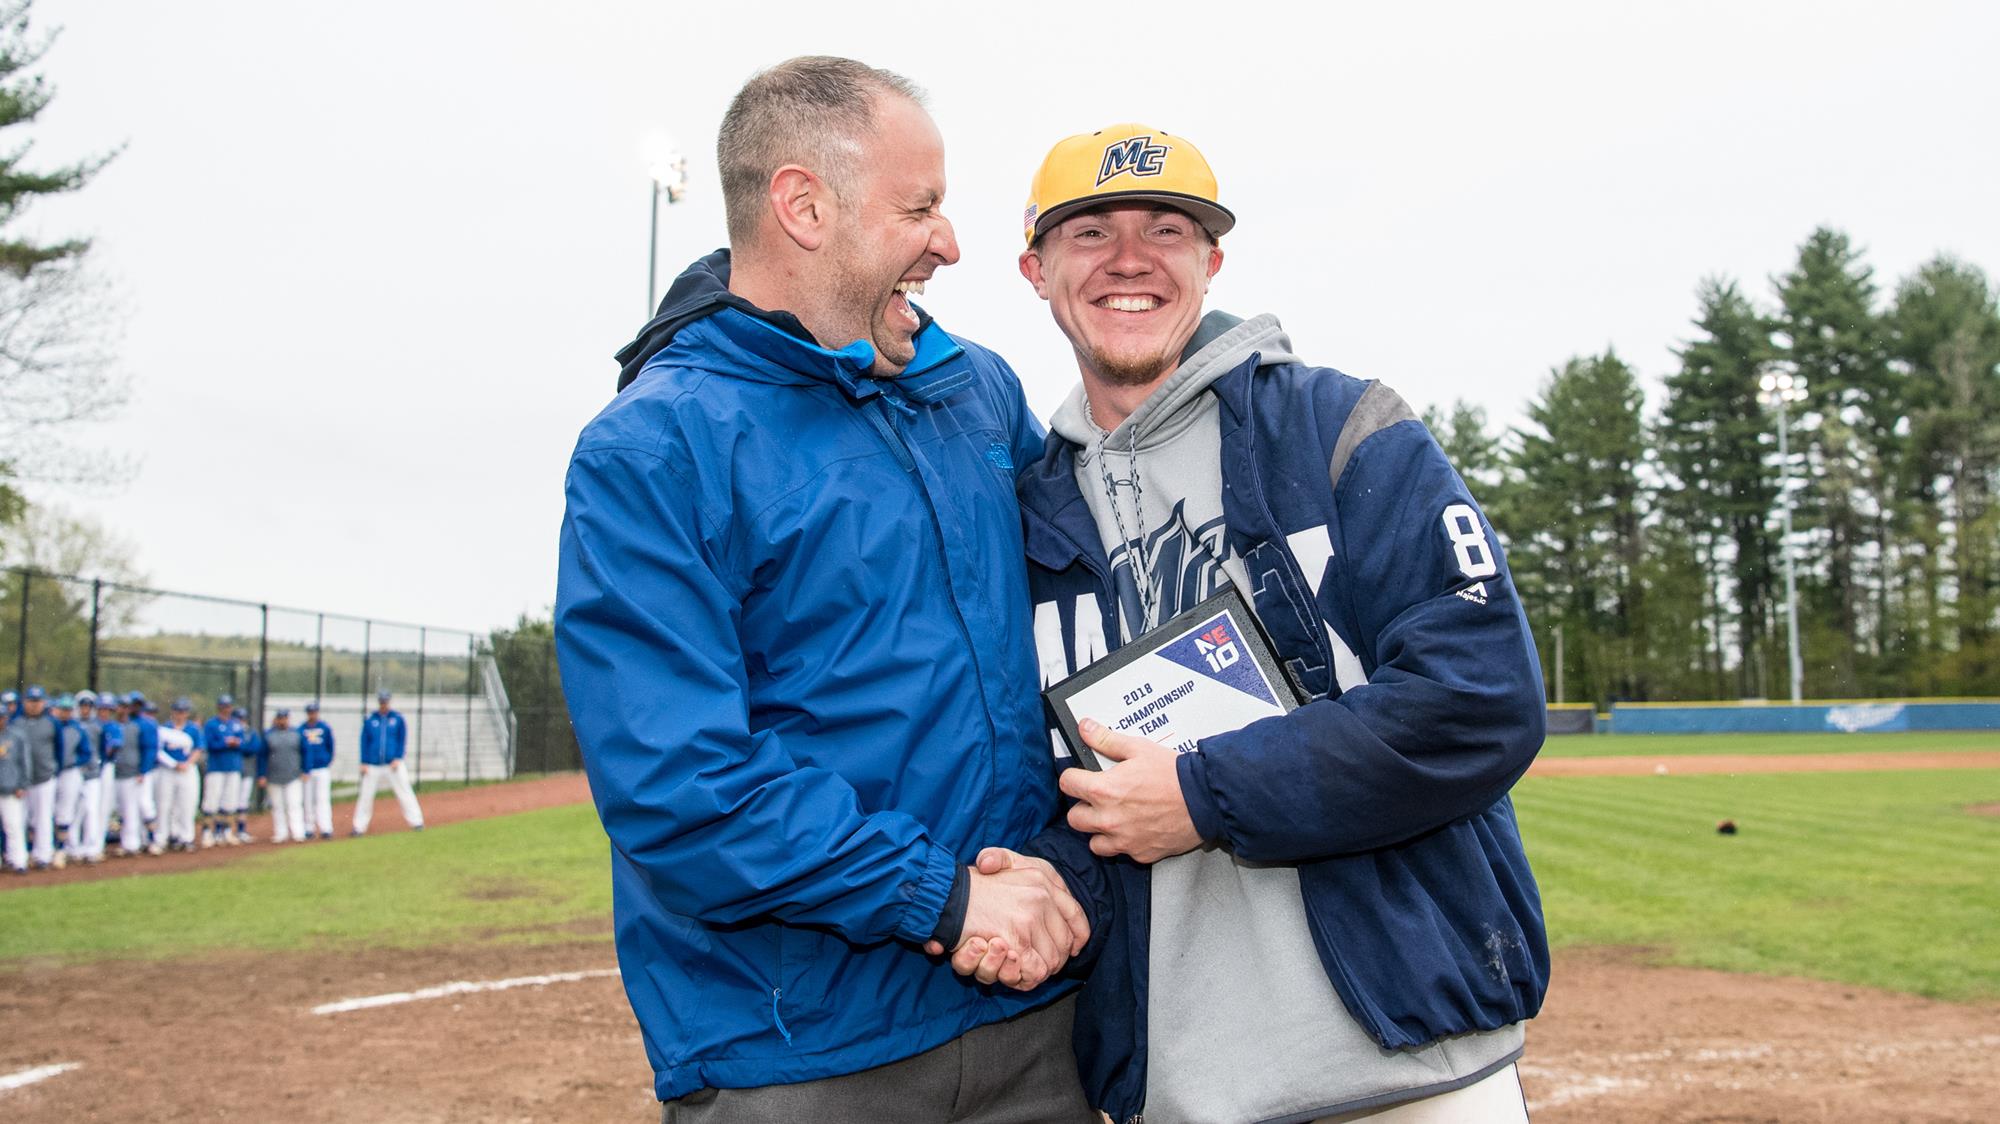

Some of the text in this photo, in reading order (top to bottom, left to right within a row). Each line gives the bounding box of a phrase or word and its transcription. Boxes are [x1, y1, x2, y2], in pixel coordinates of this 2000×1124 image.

[1096, 135, 1167, 187] MC
[1442, 504, 1497, 578] 8
[1205, 641, 1240, 673] 10
[1108, 680, 1195, 731] -CHAMPIONSHIP
[1123, 683, 1153, 706] 2018
[1138, 713, 1169, 736] TEAM
